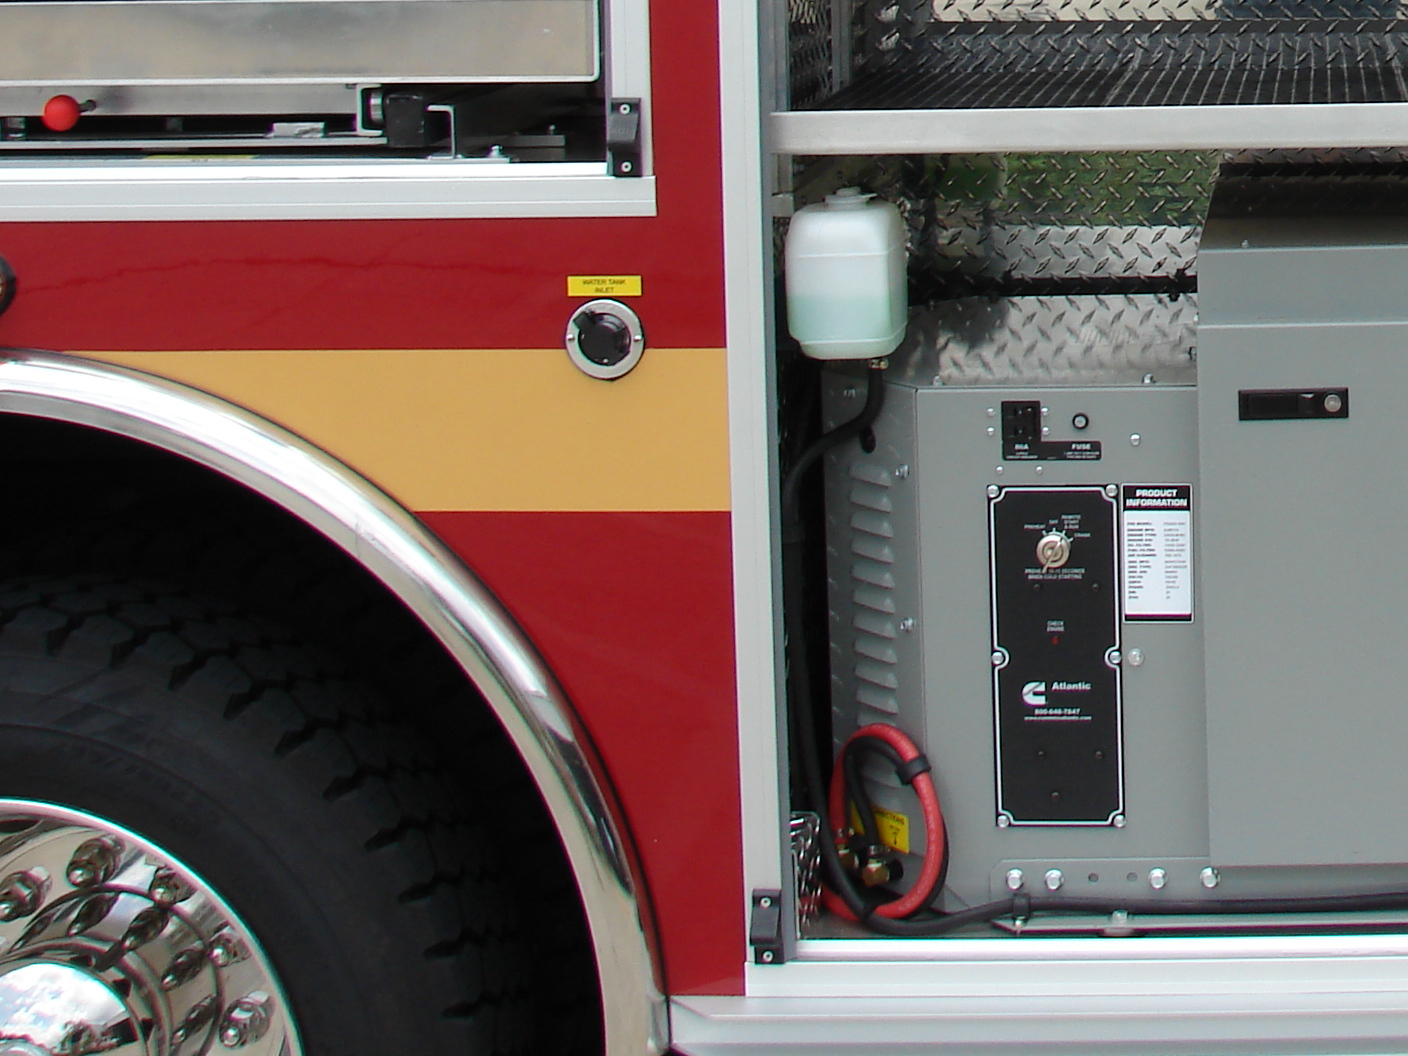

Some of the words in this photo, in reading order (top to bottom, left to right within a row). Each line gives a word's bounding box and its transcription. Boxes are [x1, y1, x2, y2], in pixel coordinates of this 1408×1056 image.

[1071, 443, 1092, 451] FUSE
[1135, 488, 1178, 498] PRODUCT
[1125, 498, 1188, 507] INFORMATION
[1051, 681, 1092, 691] Atlantic
